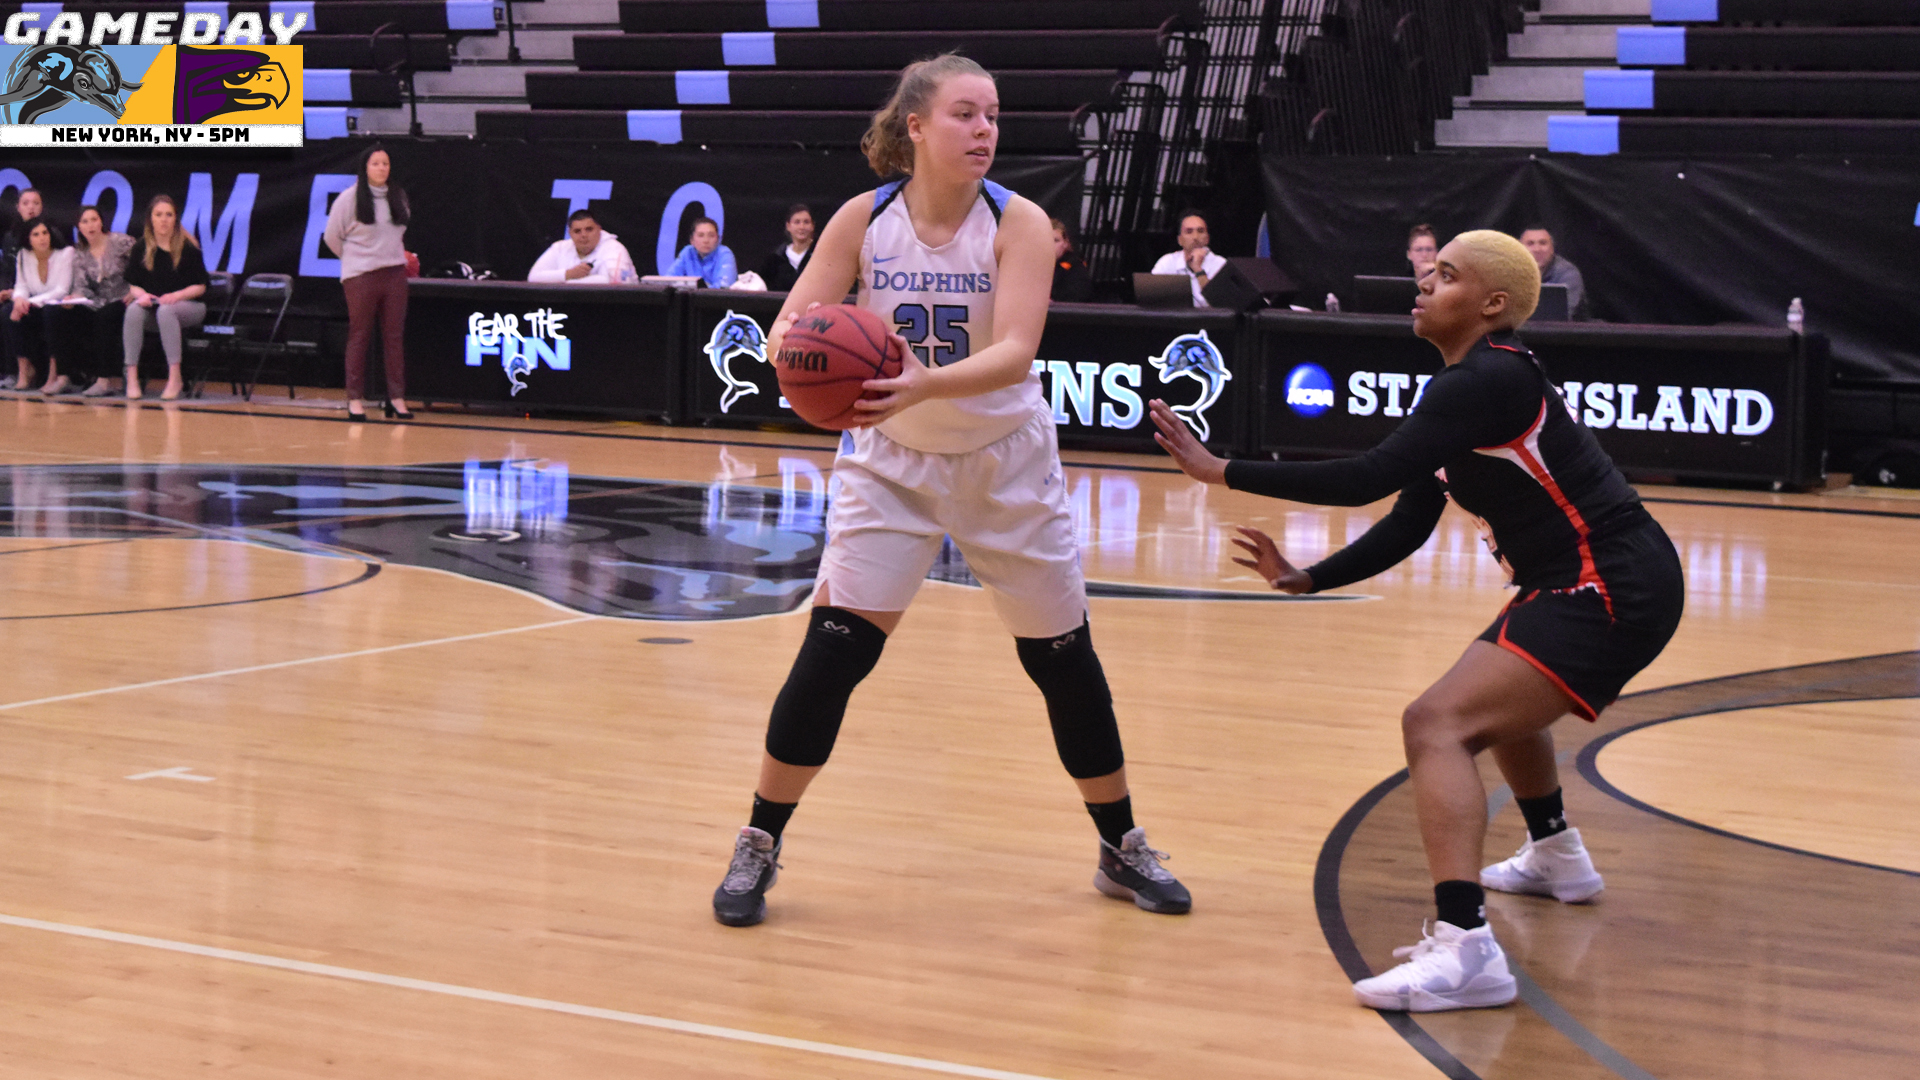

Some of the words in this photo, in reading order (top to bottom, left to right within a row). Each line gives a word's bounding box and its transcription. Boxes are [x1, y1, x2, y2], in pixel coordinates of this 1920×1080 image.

[551, 179, 724, 276] TO
[873, 270, 992, 293] DOLPHINS
[468, 311, 526, 346] FEAR
[523, 307, 568, 340] THE
[893, 303, 970, 368] 25
[464, 334, 571, 371] FIN
[1563, 381, 1773, 435] ISLAND
